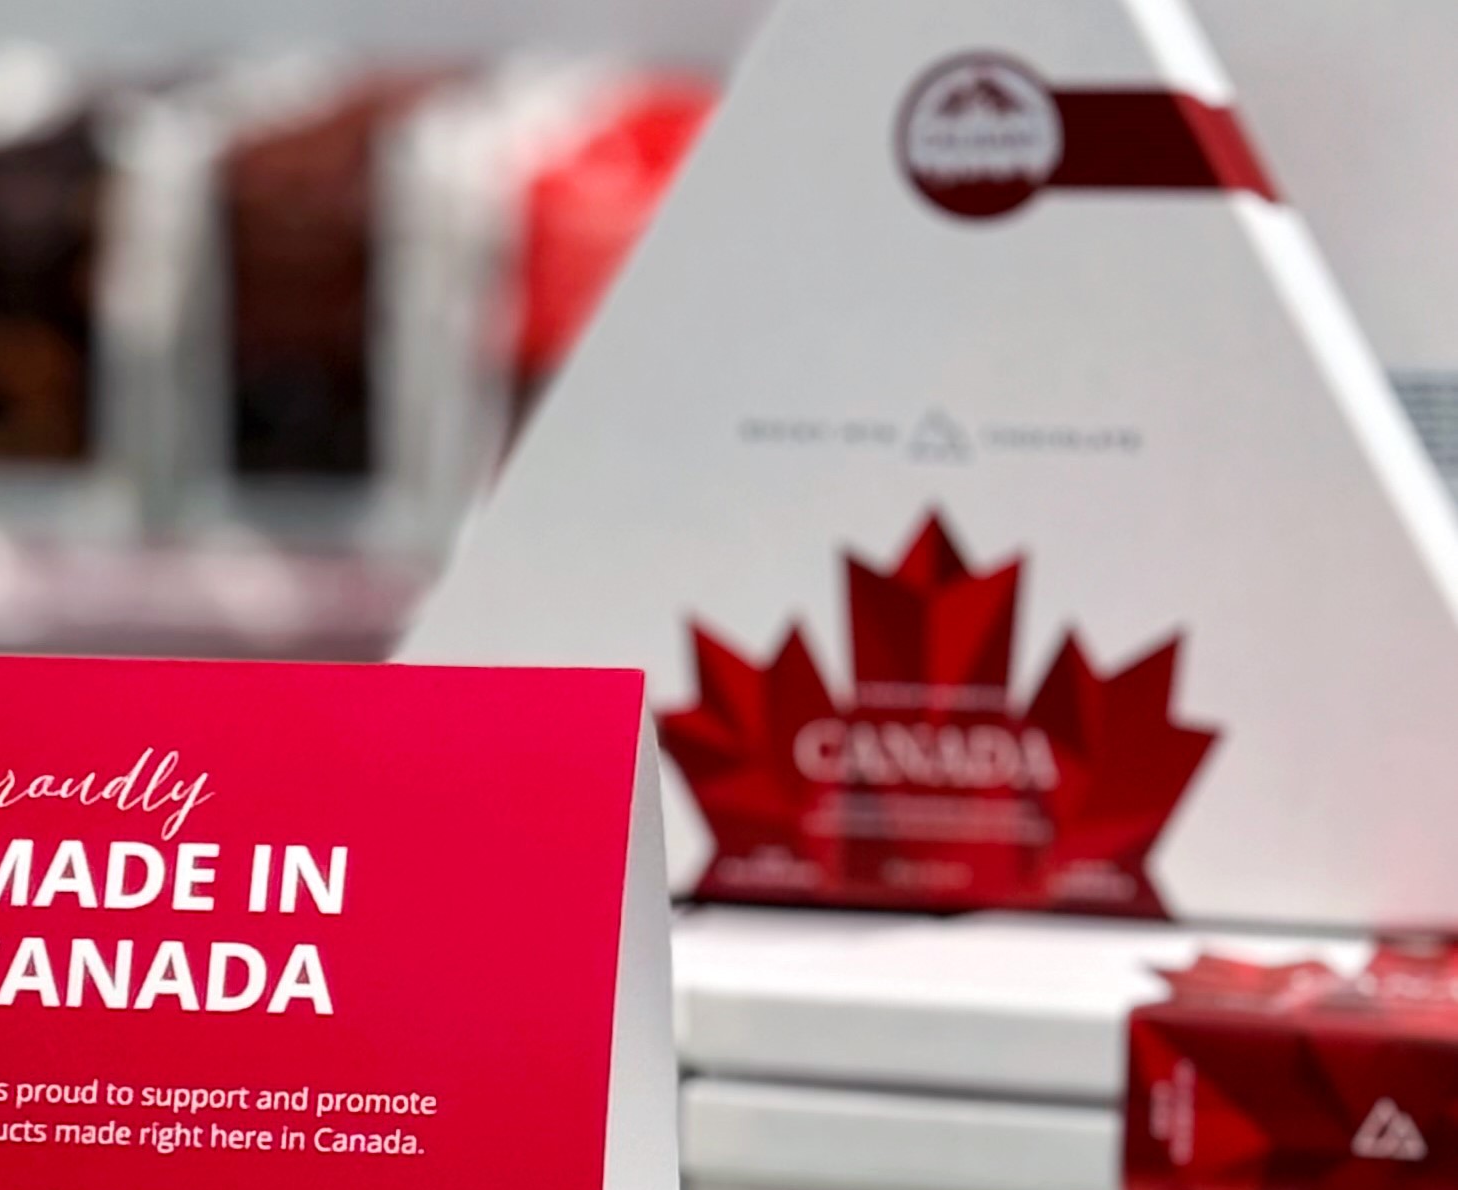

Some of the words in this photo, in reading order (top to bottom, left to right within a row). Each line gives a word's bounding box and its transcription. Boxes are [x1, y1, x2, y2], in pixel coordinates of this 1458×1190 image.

[792, 717, 1060, 791] CANADA
[248, 843, 349, 915] IN
[16, 1079, 99, 1108] proud
[106, 1083, 134, 1106] to
[141, 1087, 250, 1114] support
[256, 1086, 309, 1111] and
[316, 1092, 437, 1118] promote
[55, 1120, 132, 1146] made
[139, 1122, 203, 1154] right
[210, 1123, 273, 1150] here
[280, 1126, 305, 1150] in
[313, 1127, 425, 1155] Canada.
